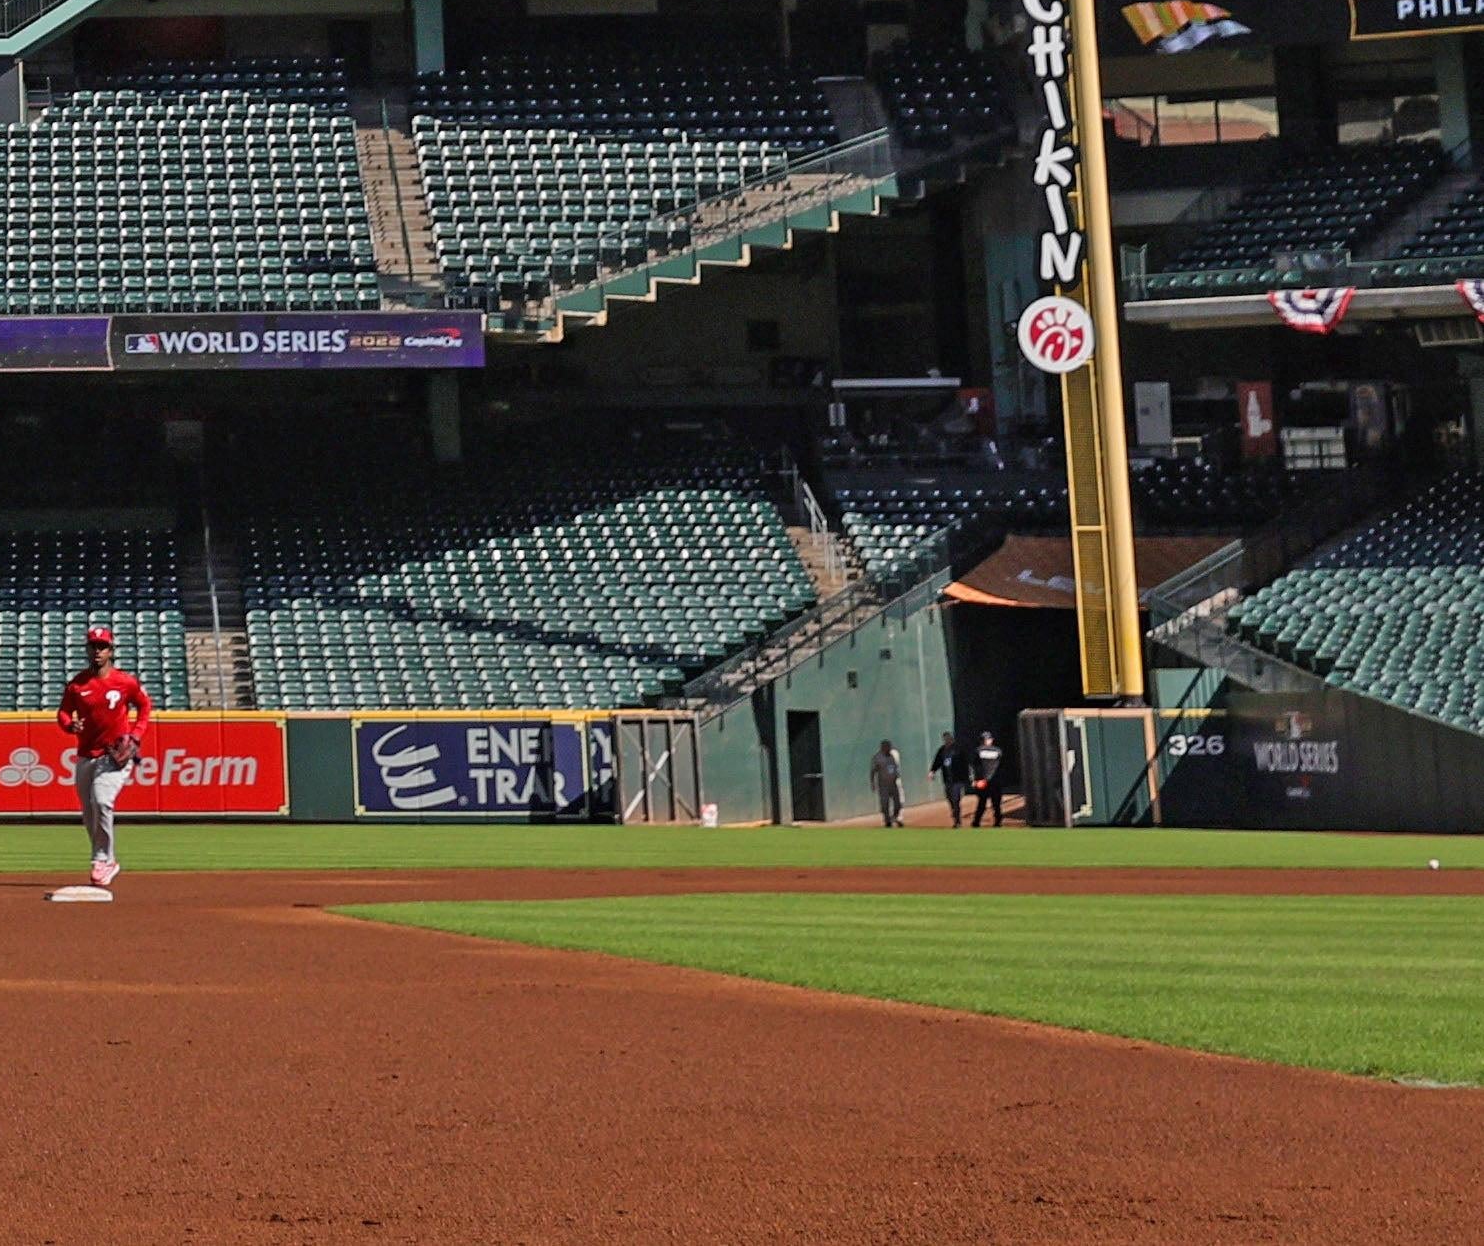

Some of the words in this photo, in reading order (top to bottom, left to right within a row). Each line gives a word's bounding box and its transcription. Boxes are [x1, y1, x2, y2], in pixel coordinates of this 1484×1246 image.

[159, 331, 259, 354] WORLD
[261, 330, 347, 353] SERIES
[349, 336, 402, 348] 2022
[1168, 735, 1225, 755] 326
